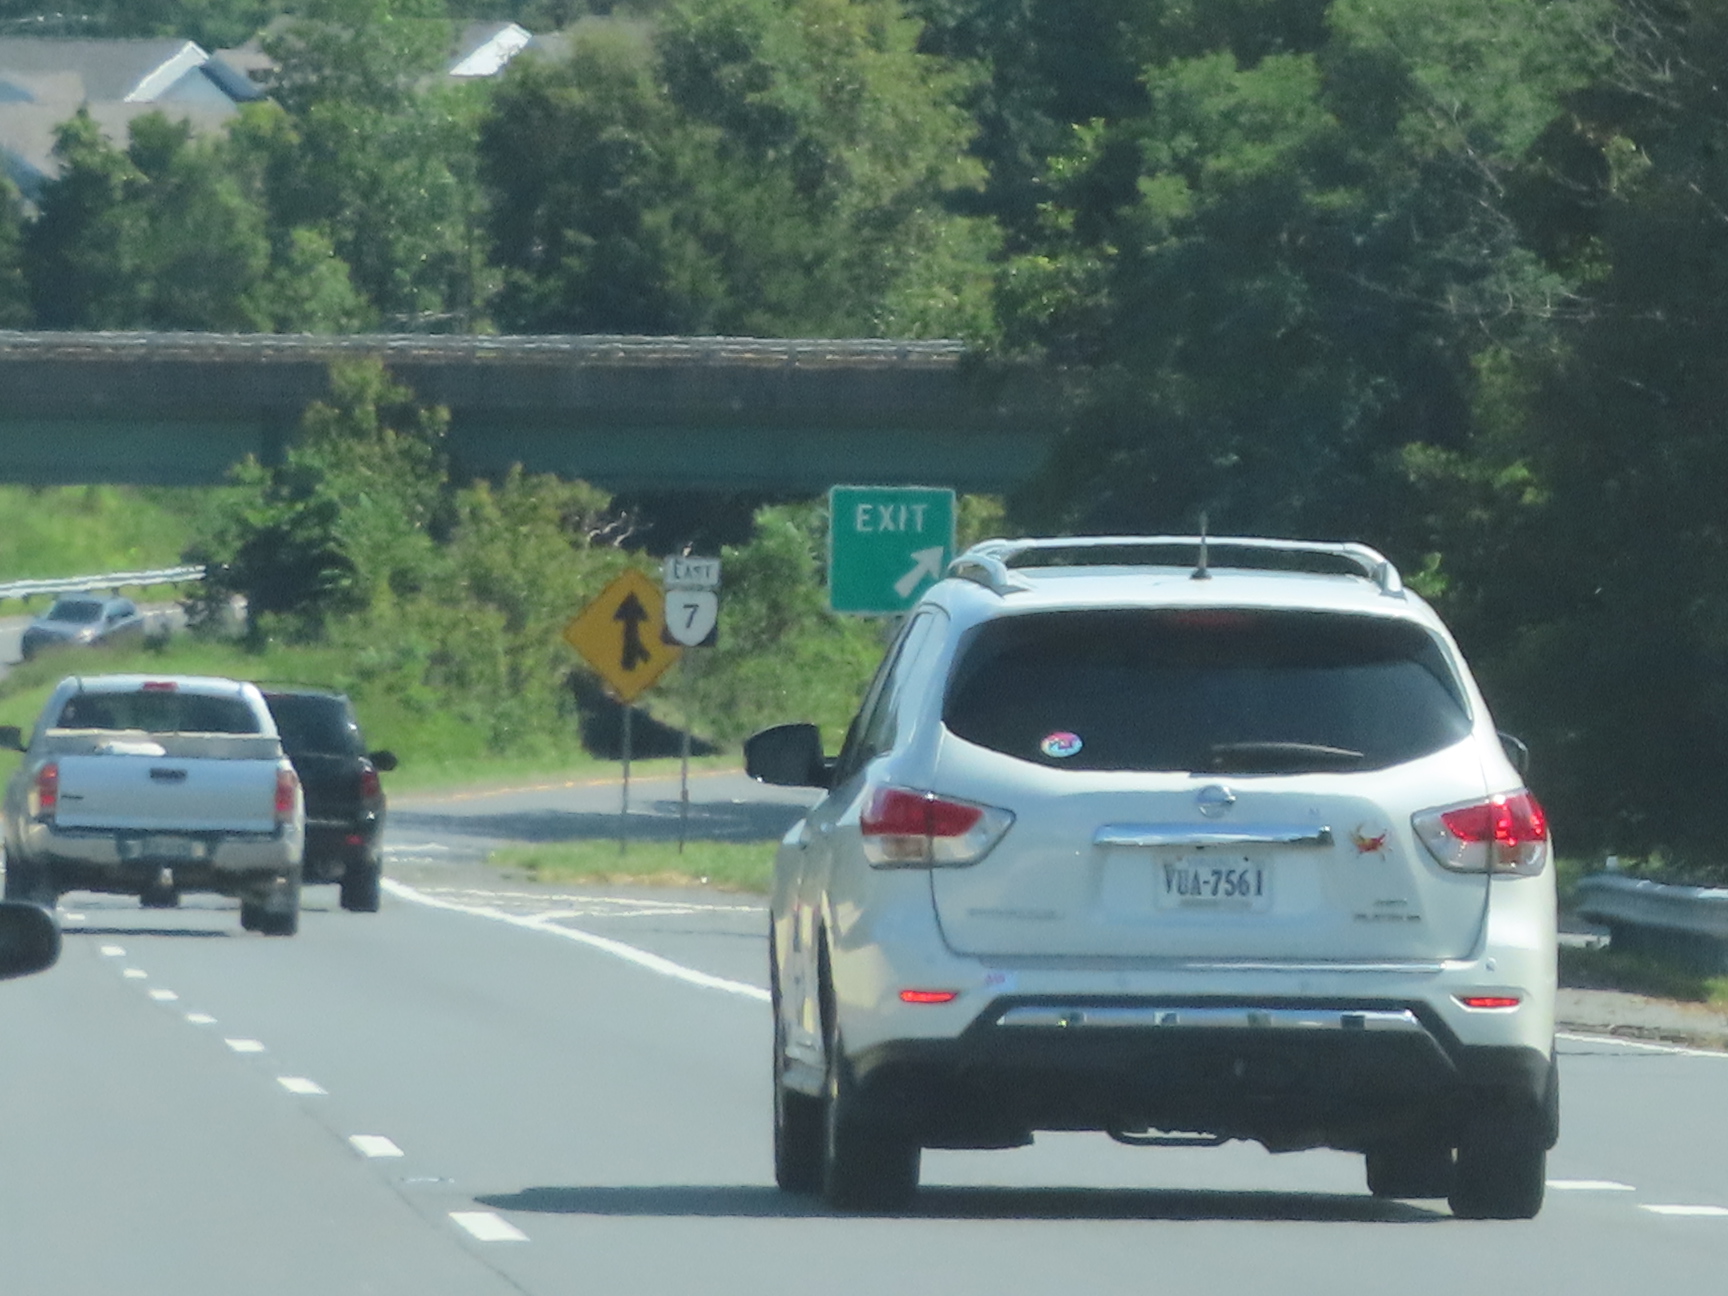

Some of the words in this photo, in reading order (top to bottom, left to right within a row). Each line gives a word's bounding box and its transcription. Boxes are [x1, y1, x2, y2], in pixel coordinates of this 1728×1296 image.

[856, 503, 928, 532] EXIT
[673, 559, 713, 580] EAST
[683, 604, 699, 629] 7
